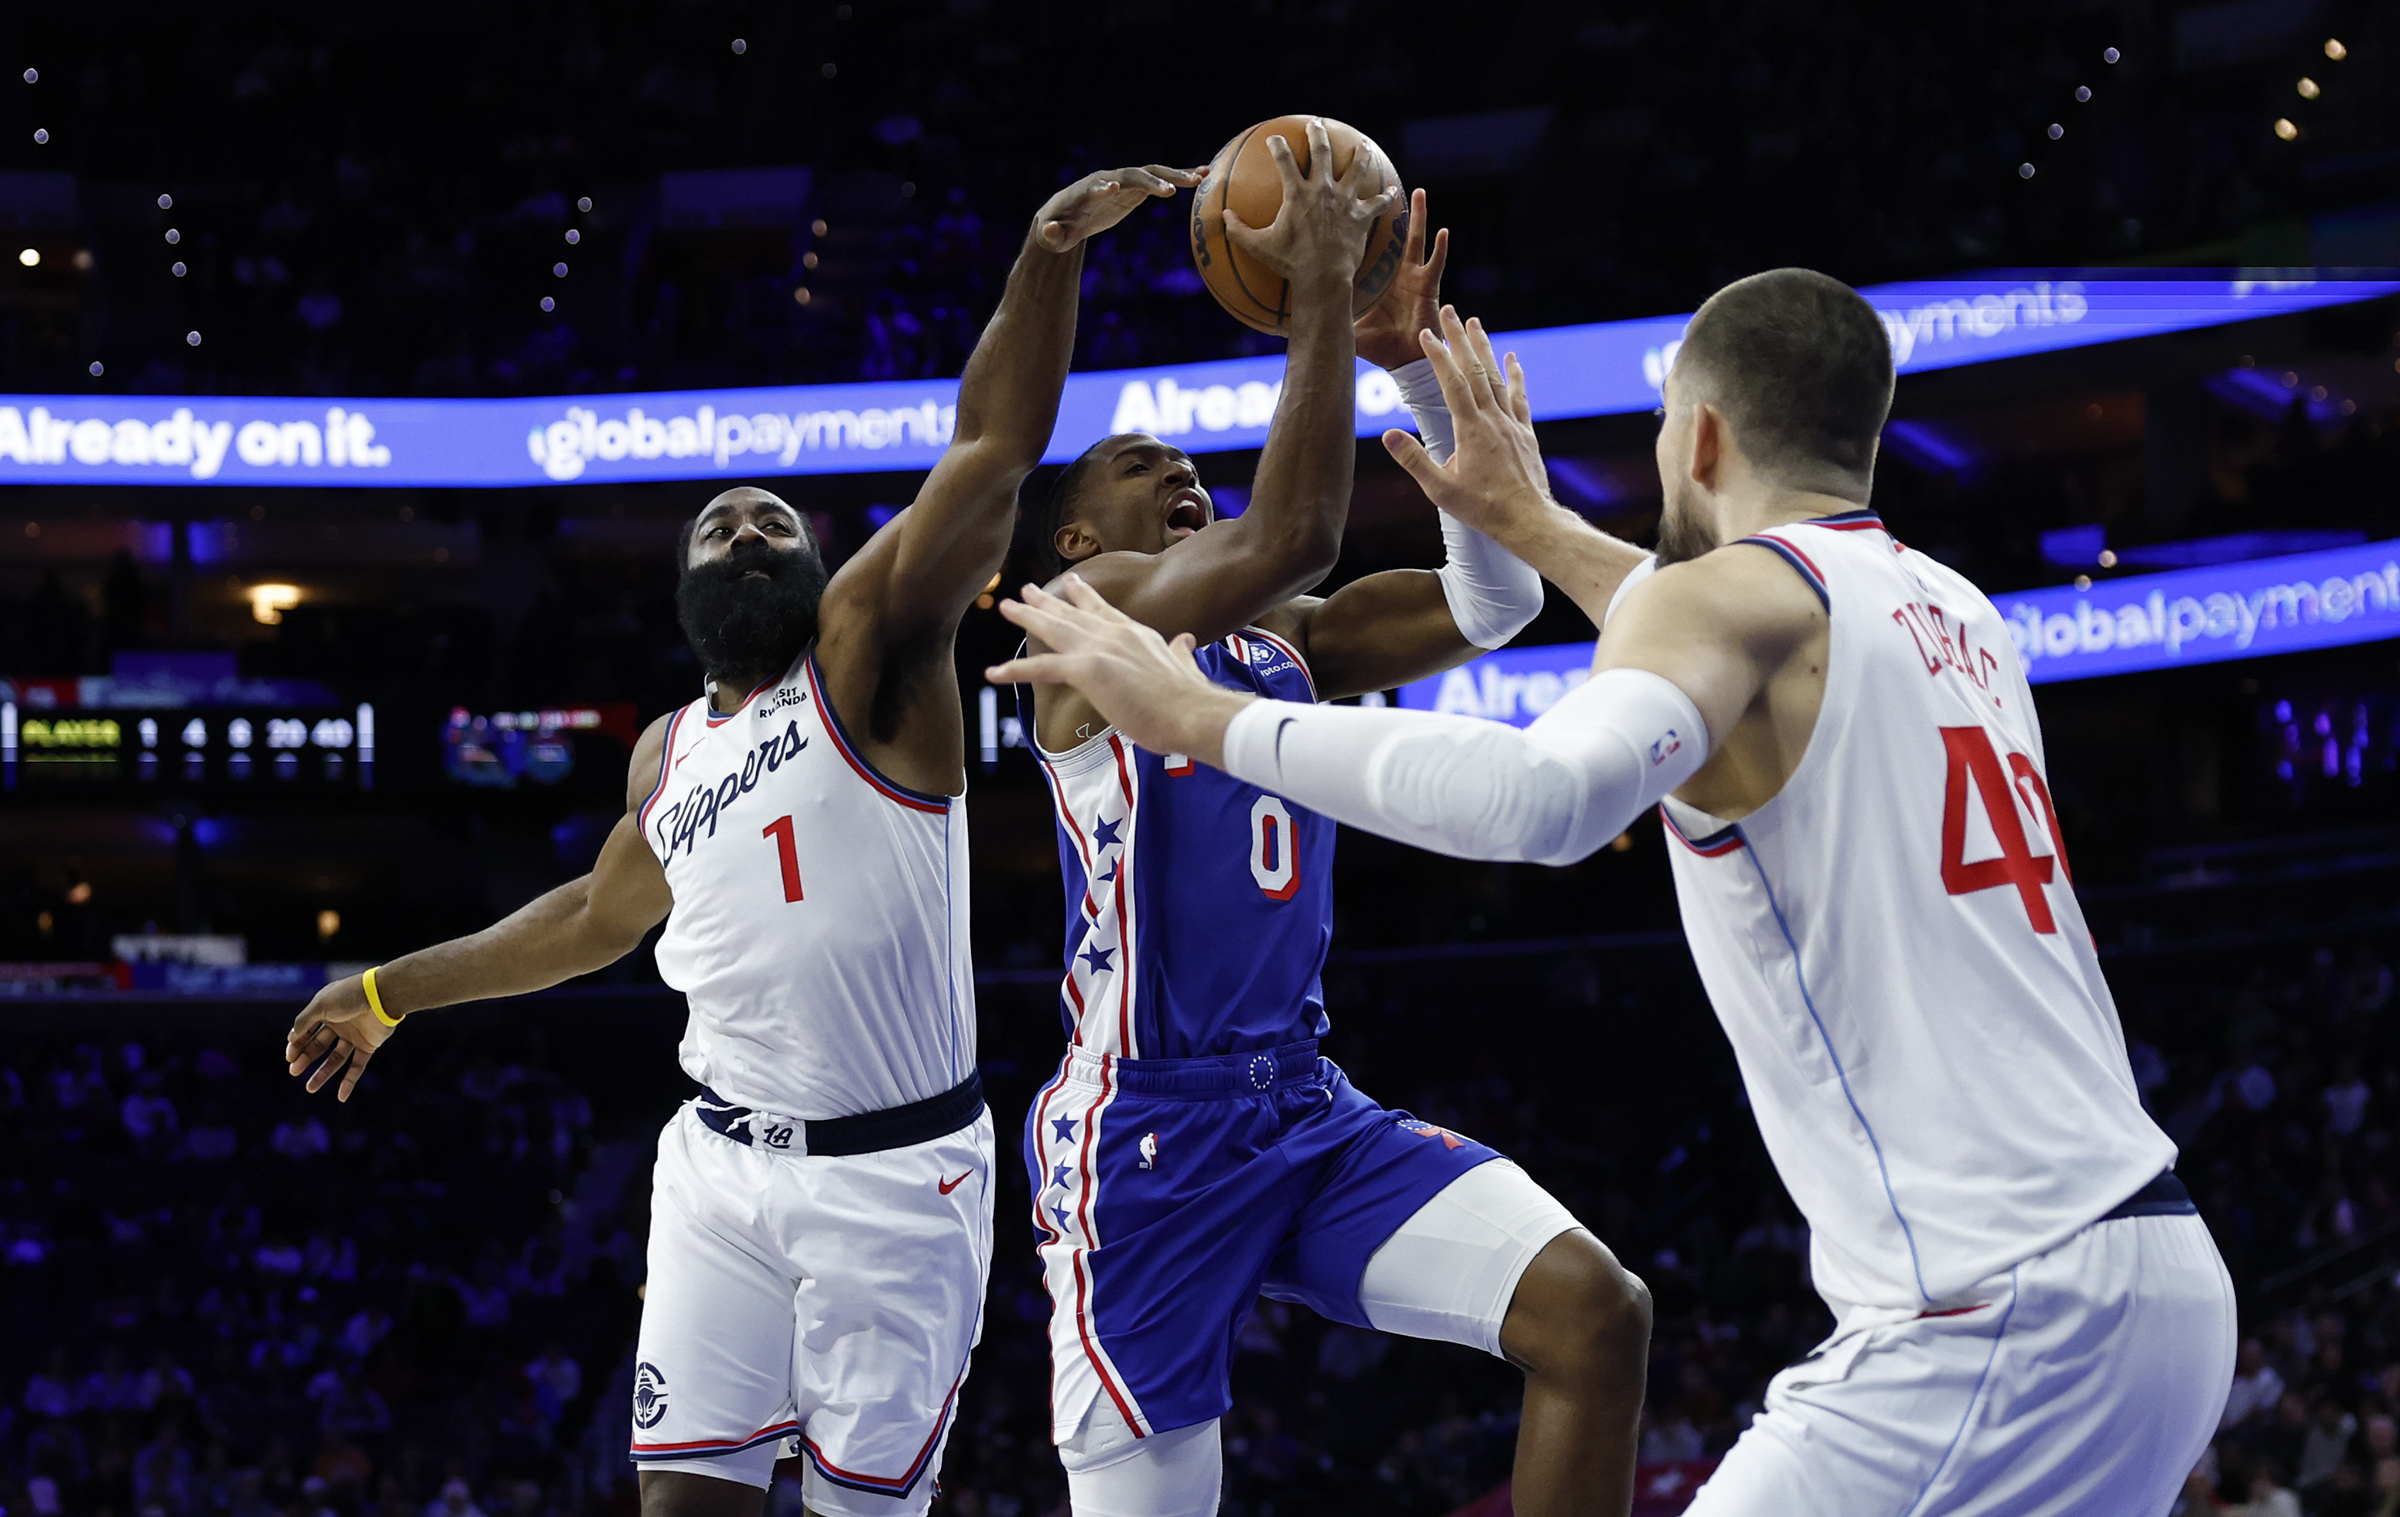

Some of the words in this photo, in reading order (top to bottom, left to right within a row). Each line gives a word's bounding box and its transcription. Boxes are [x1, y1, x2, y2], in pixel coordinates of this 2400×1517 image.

[0, 406, 234, 480] Already
[236, 418, 323, 467] on
[326, 405, 392, 467] it.
[1110, 377, 1284, 435] Alrea
[657, 719, 809, 869] Clippers
[763, 814, 804, 903] 1
[1249, 793, 1300, 901] 0
